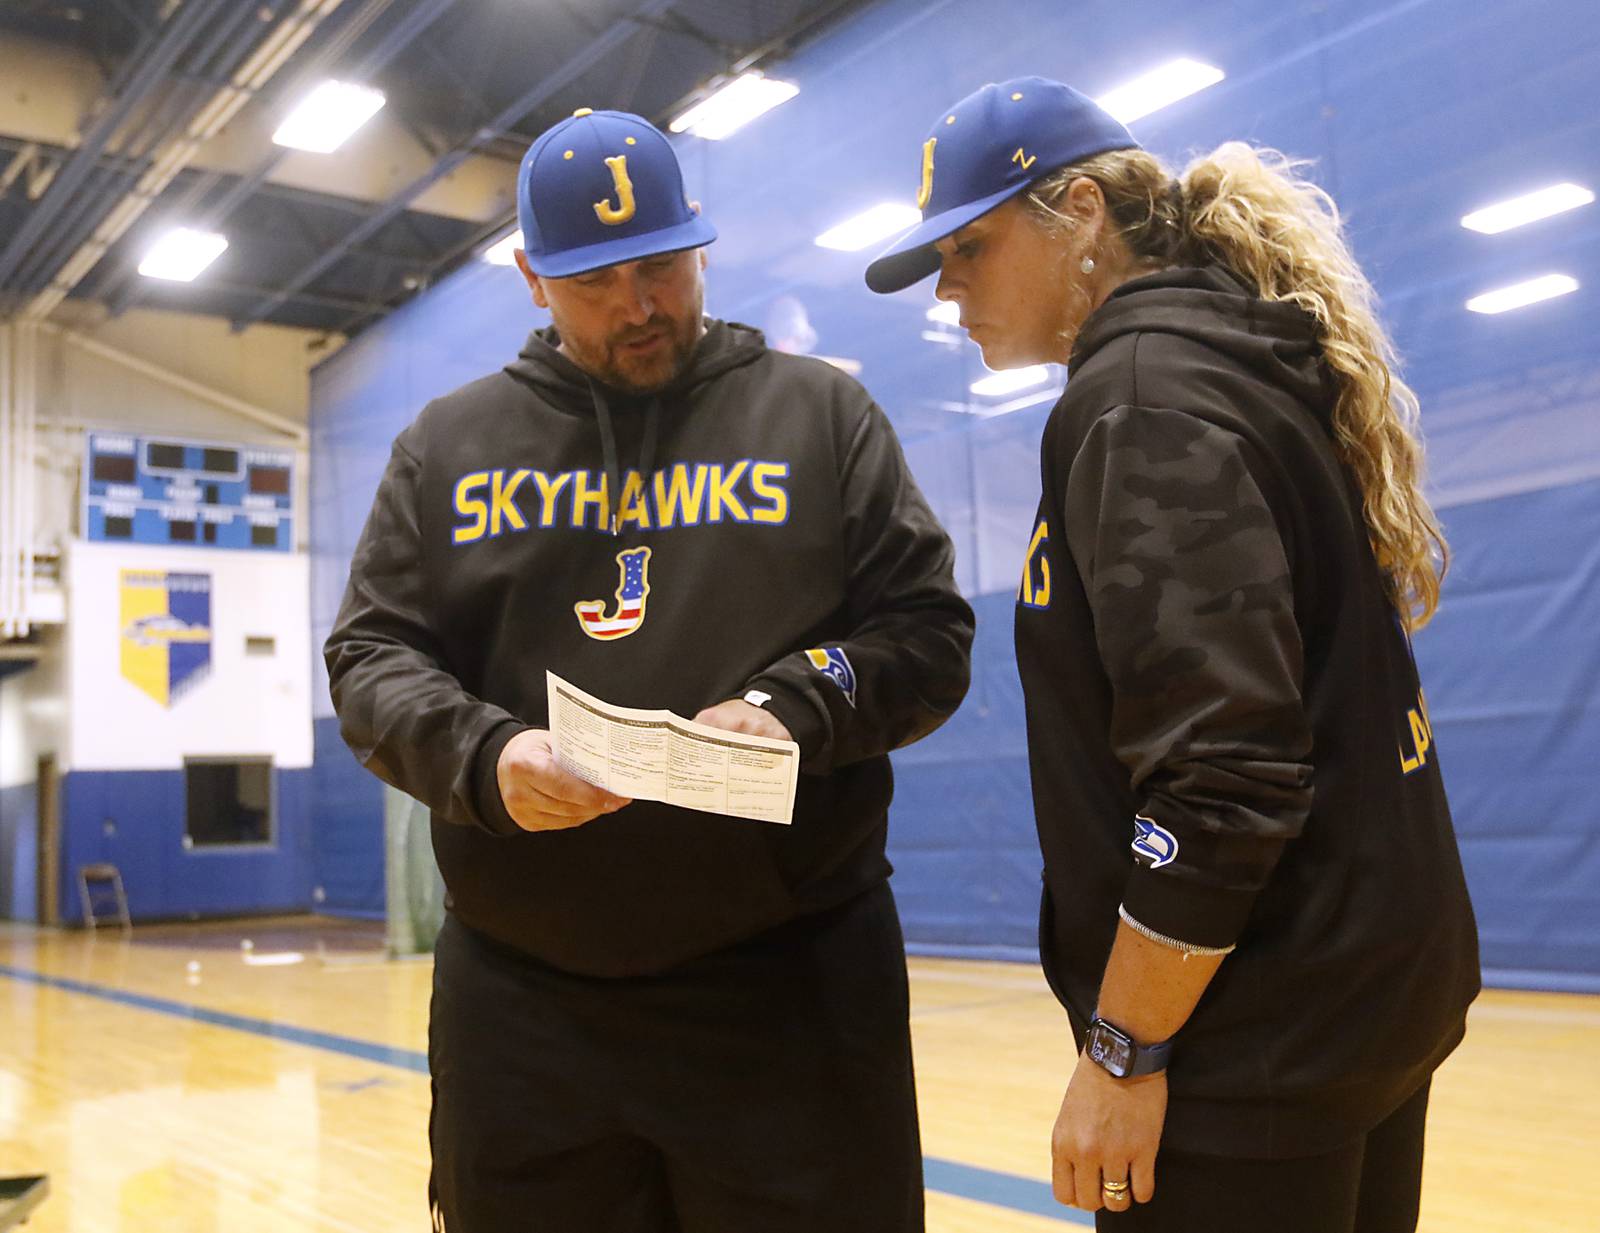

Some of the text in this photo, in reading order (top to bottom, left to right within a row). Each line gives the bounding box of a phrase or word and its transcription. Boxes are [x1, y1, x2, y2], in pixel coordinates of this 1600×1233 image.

[593, 154, 636, 226] J
[918, 137, 938, 209] J
[451, 459, 791, 546] SKYHAWKS
[574, 545, 653, 642] J
